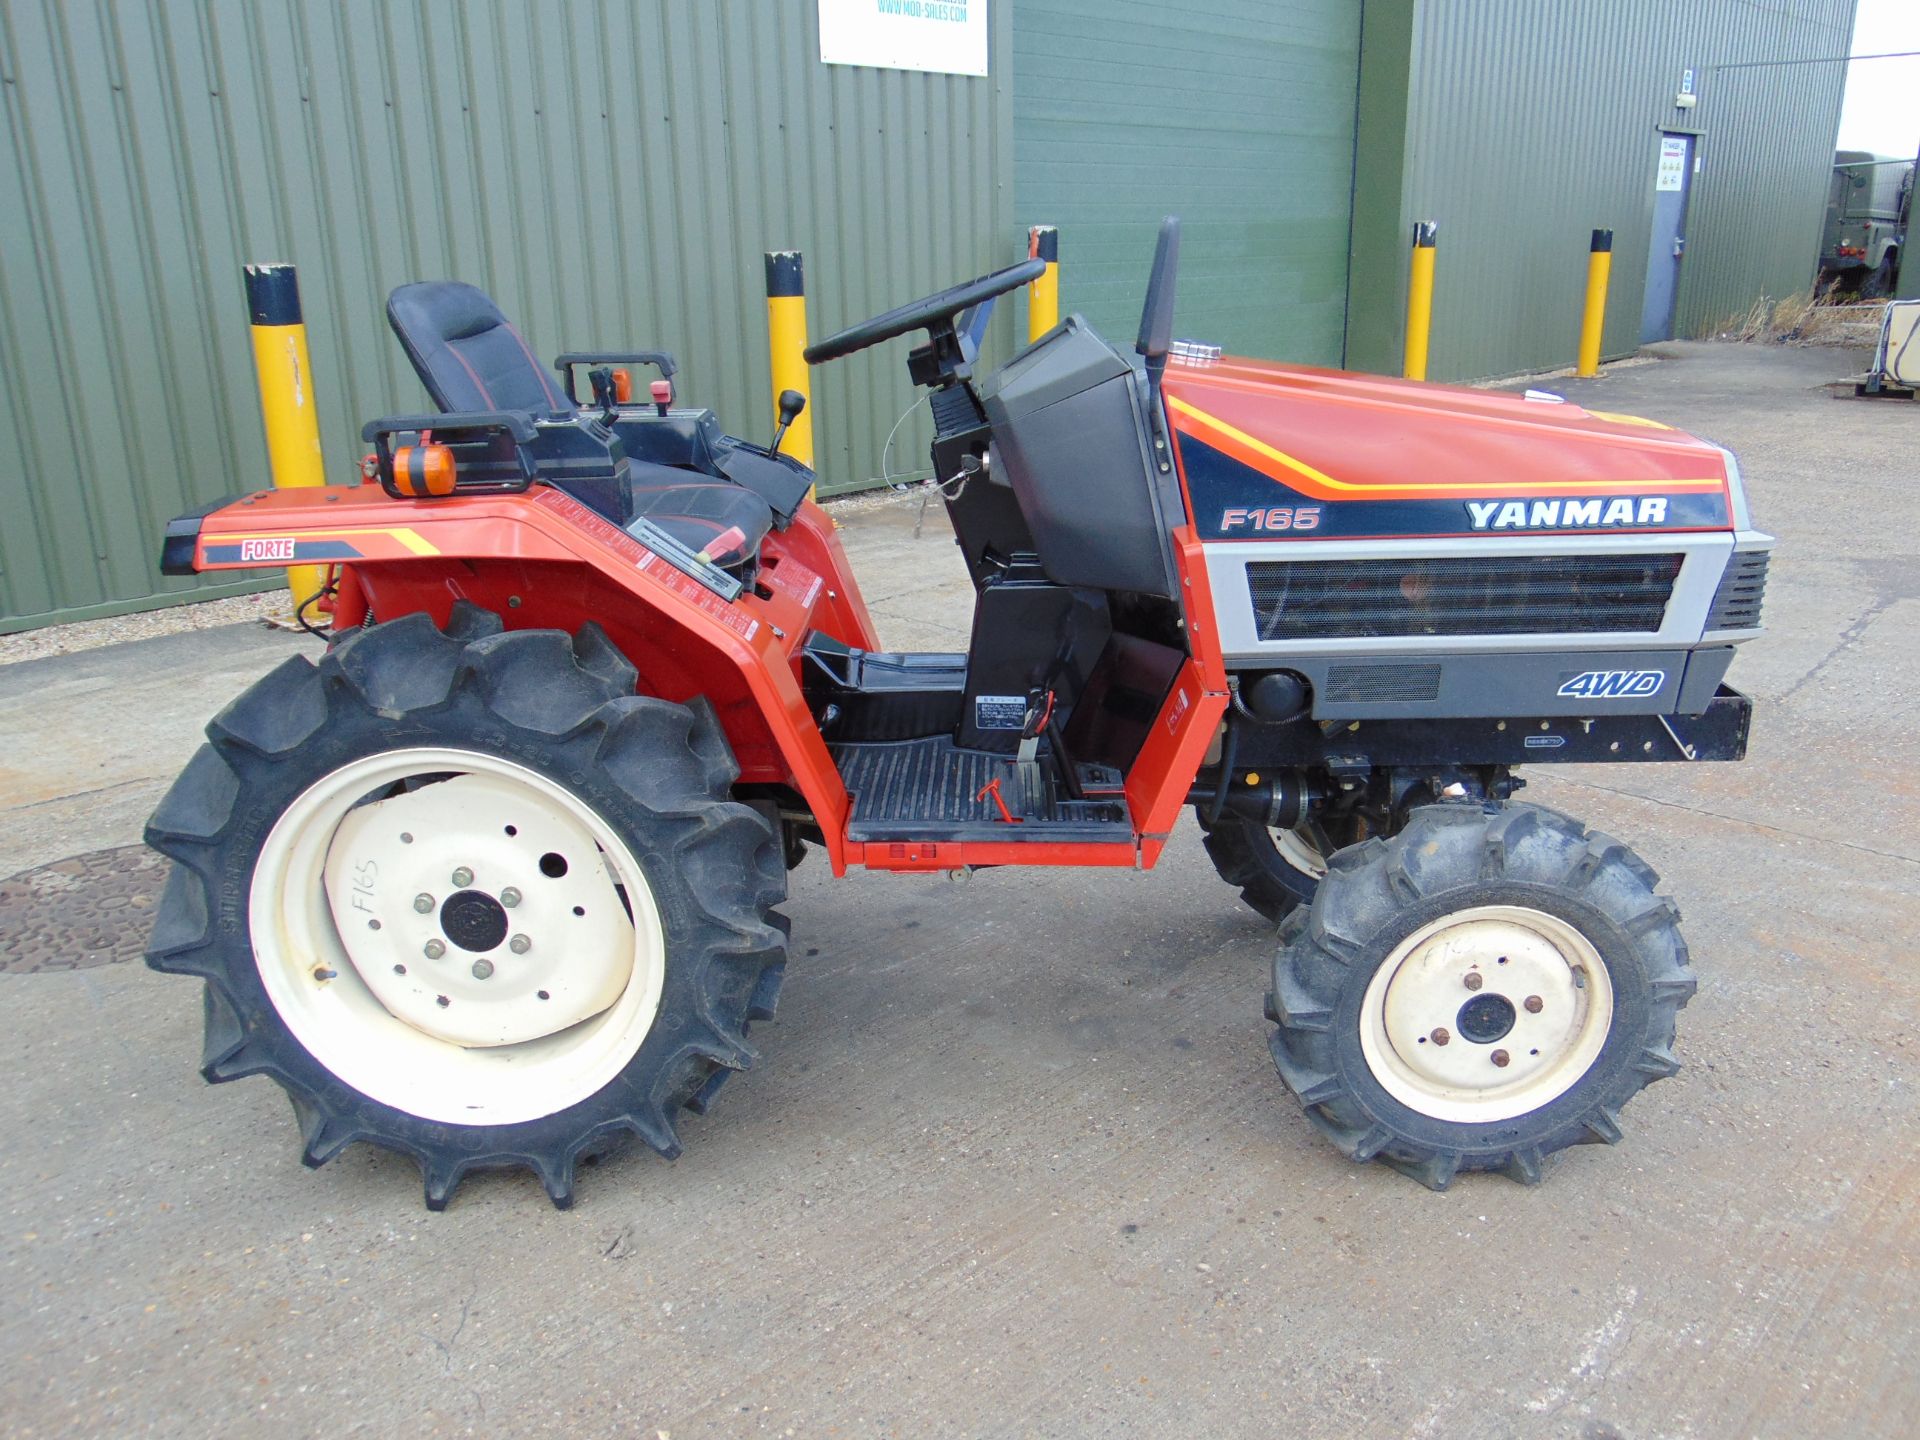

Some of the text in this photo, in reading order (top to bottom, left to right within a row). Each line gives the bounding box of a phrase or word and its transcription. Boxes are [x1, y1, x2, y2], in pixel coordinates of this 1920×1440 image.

[1220, 507, 1321, 531] F165
[1468, 498, 1668, 528] YANMAR
[243, 539, 294, 560] FORTE
[1556, 670, 1665, 698] 4WD
[351, 859, 378, 914] F165
